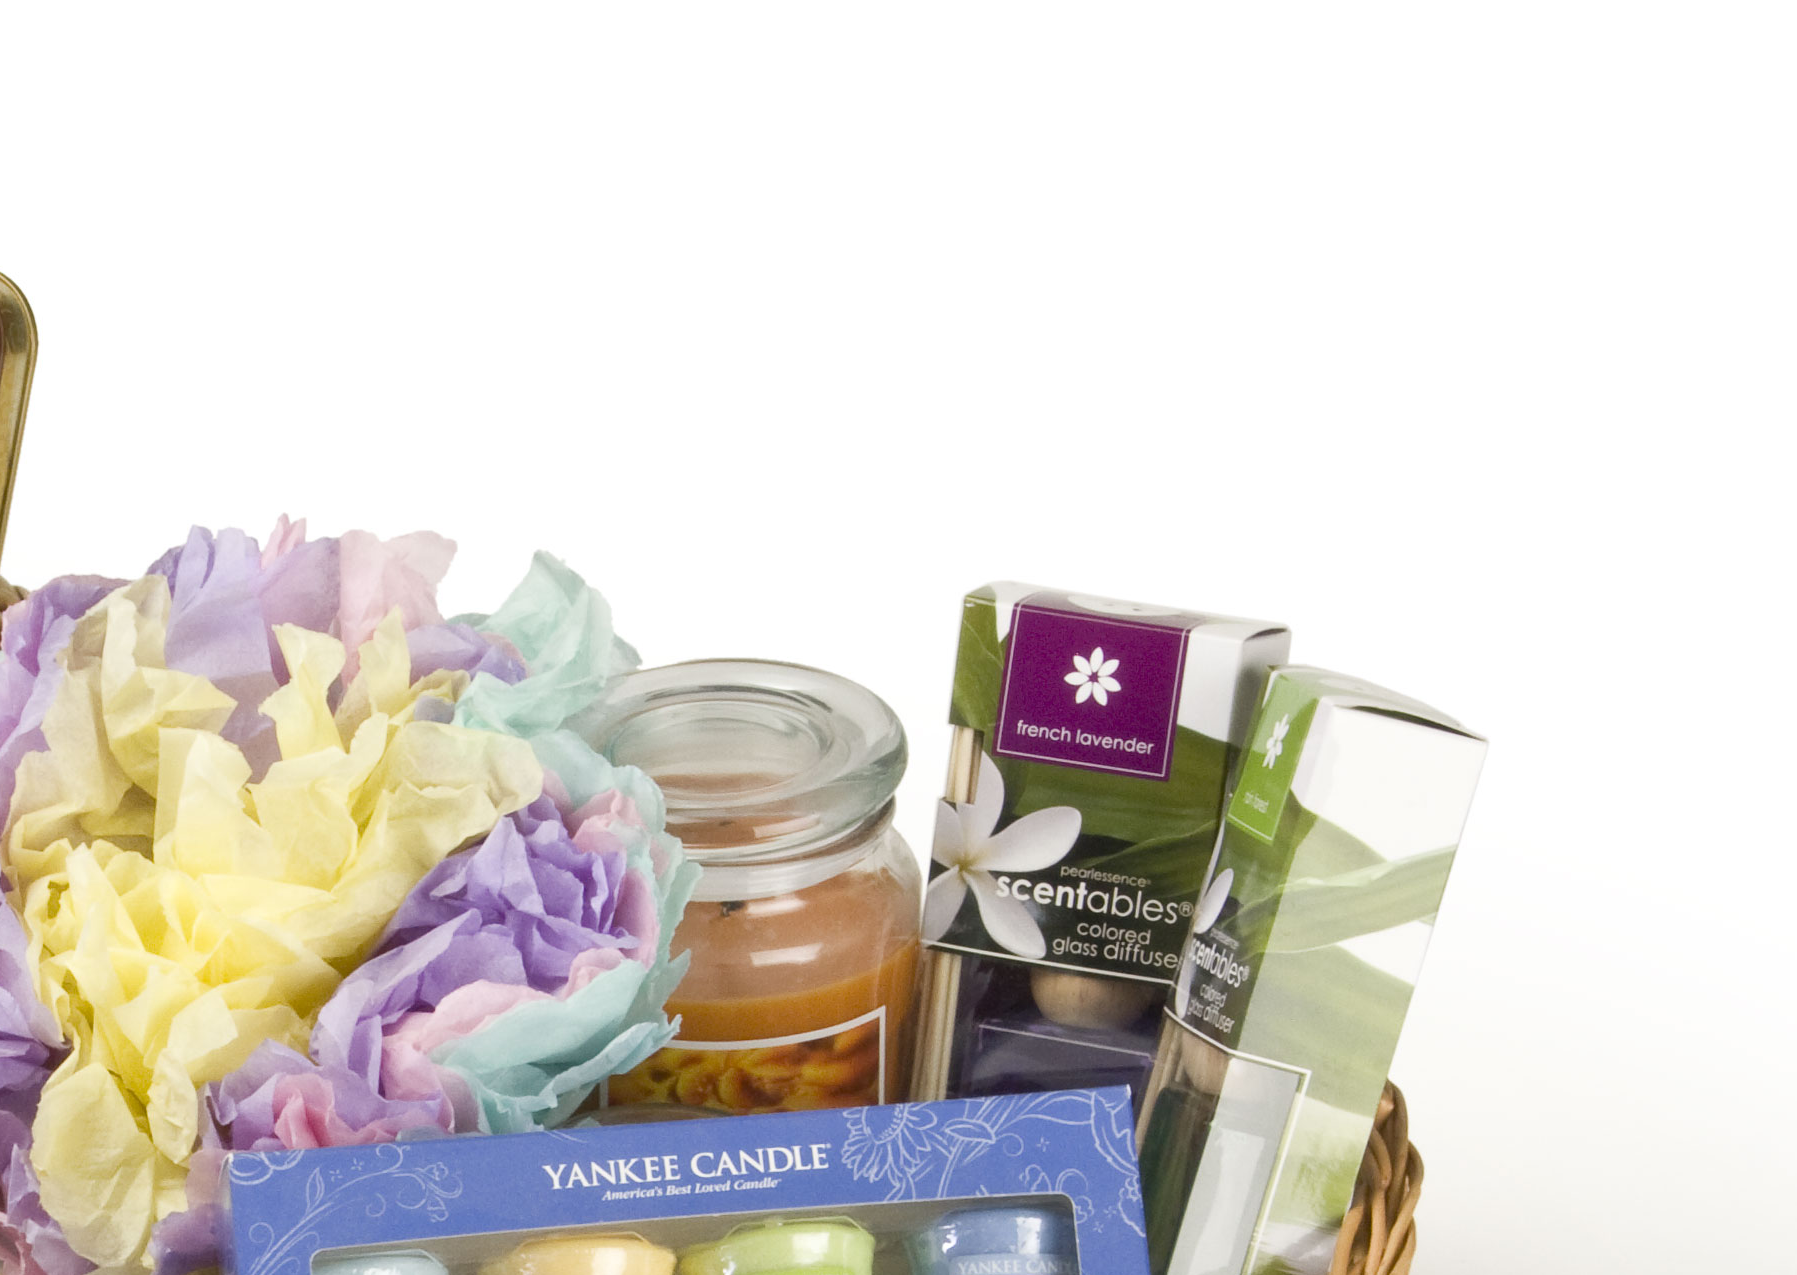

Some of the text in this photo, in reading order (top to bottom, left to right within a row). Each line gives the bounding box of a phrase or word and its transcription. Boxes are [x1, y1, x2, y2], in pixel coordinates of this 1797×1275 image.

[1016, 719, 1155, 756] french lavender
[1076, 921, 1152, 946] colored
[1052, 936, 1099, 957] glass
[541, 1154, 682, 1190] YANKEE
[601, 1185, 664, 1202] America's
[666, 1183, 693, 1197] Best
[694, 1178, 732, 1194] Loved
[957, 1260, 1020, 1275] YANKEE
